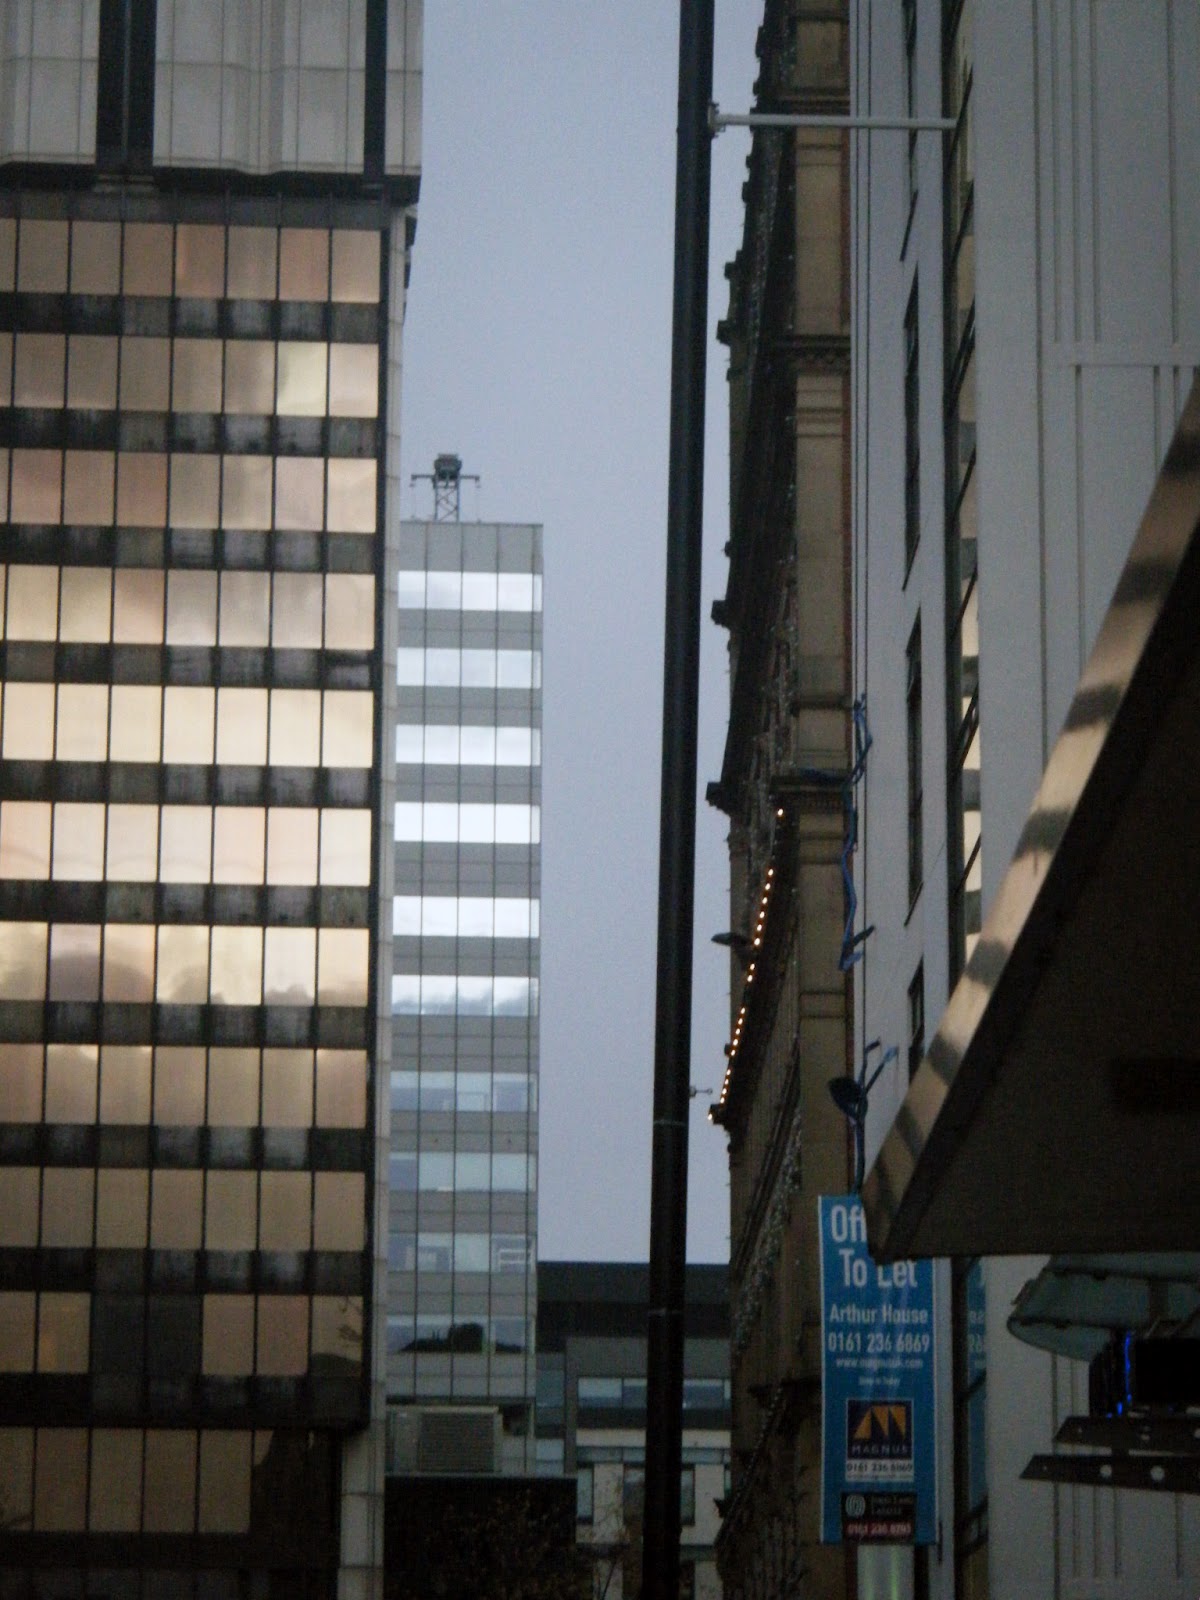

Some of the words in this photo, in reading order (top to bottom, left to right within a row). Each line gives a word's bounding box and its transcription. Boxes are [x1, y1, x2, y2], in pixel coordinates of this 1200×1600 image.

[838, 1248, 867, 1288] To
[877, 1259, 918, 1288] Let
[829, 1303, 877, 1324] Arthur
[881, 1303, 929, 1325] House
[828, 1331, 861, 1353] 0161
[867, 1332, 892, 1353] 236
[896, 1332, 930, 1353] 6869
